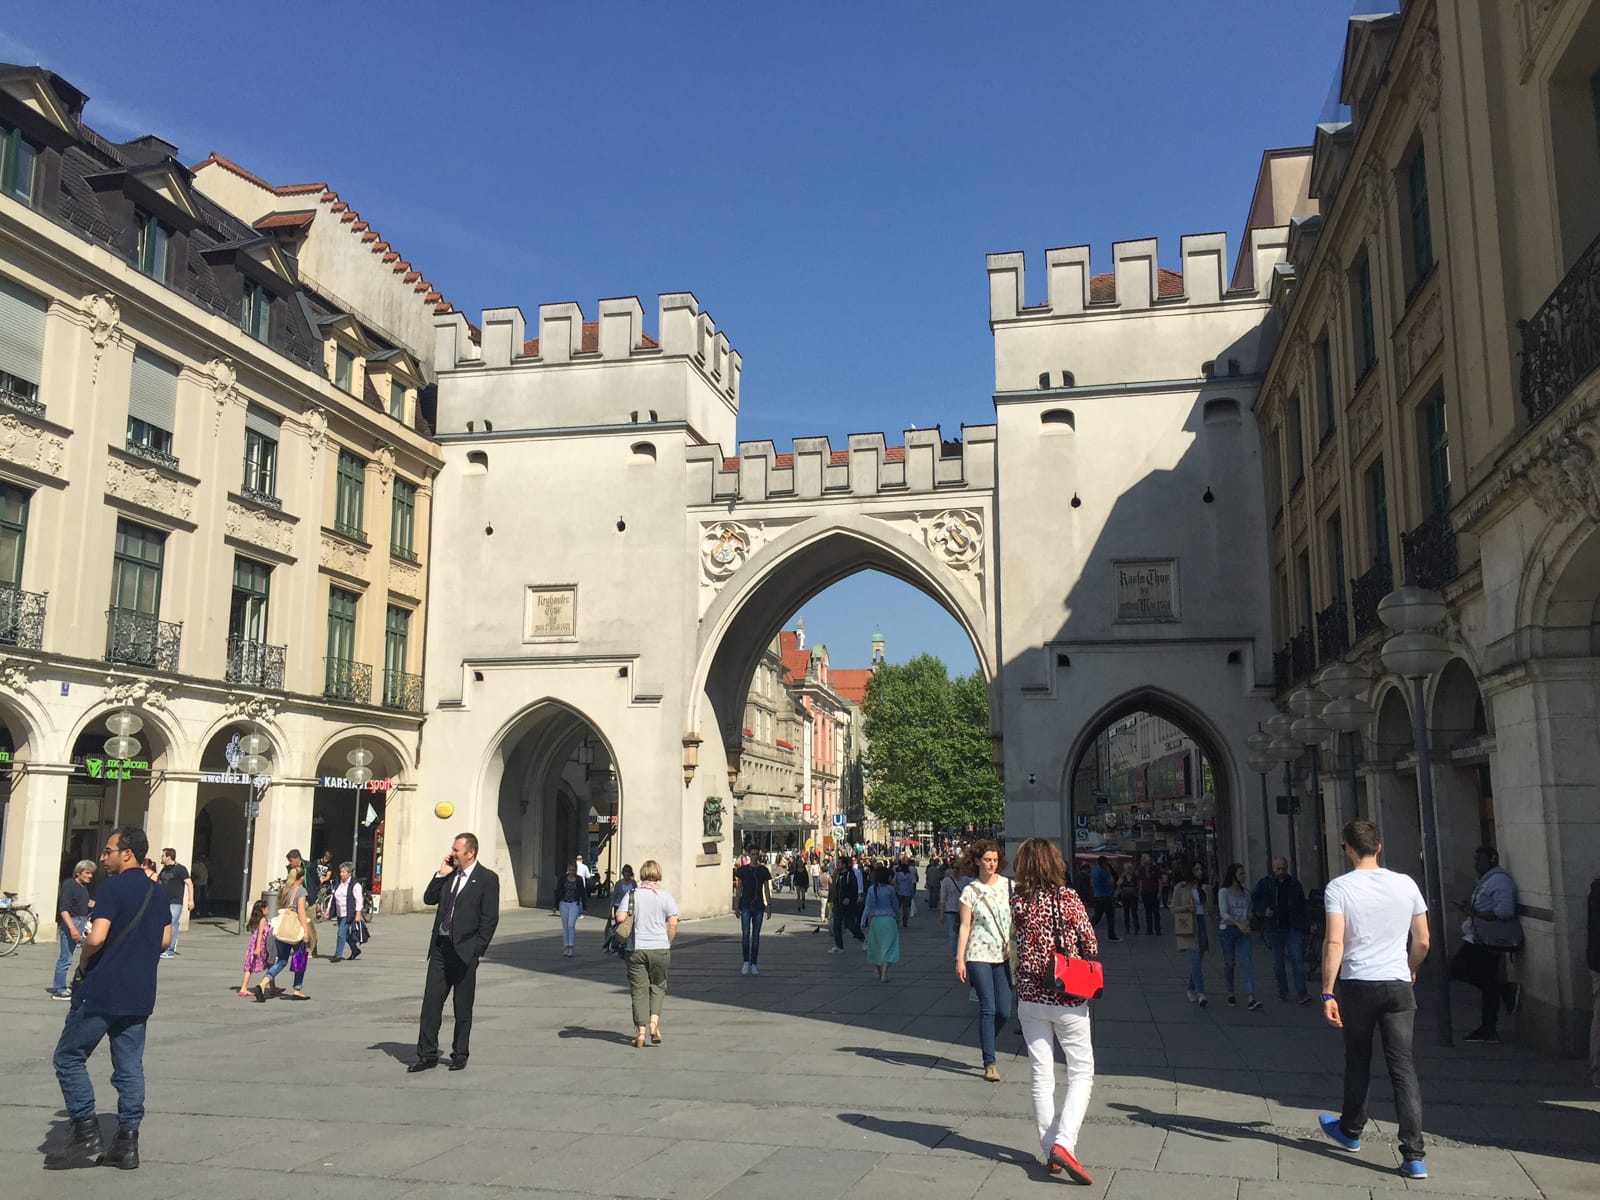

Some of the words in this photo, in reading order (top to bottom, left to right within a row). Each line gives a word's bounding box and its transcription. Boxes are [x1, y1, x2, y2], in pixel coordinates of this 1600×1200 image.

[107, 758, 149, 769] moilcom
[834, 815, 843, 825] U
[1077, 815, 1087, 826] U
